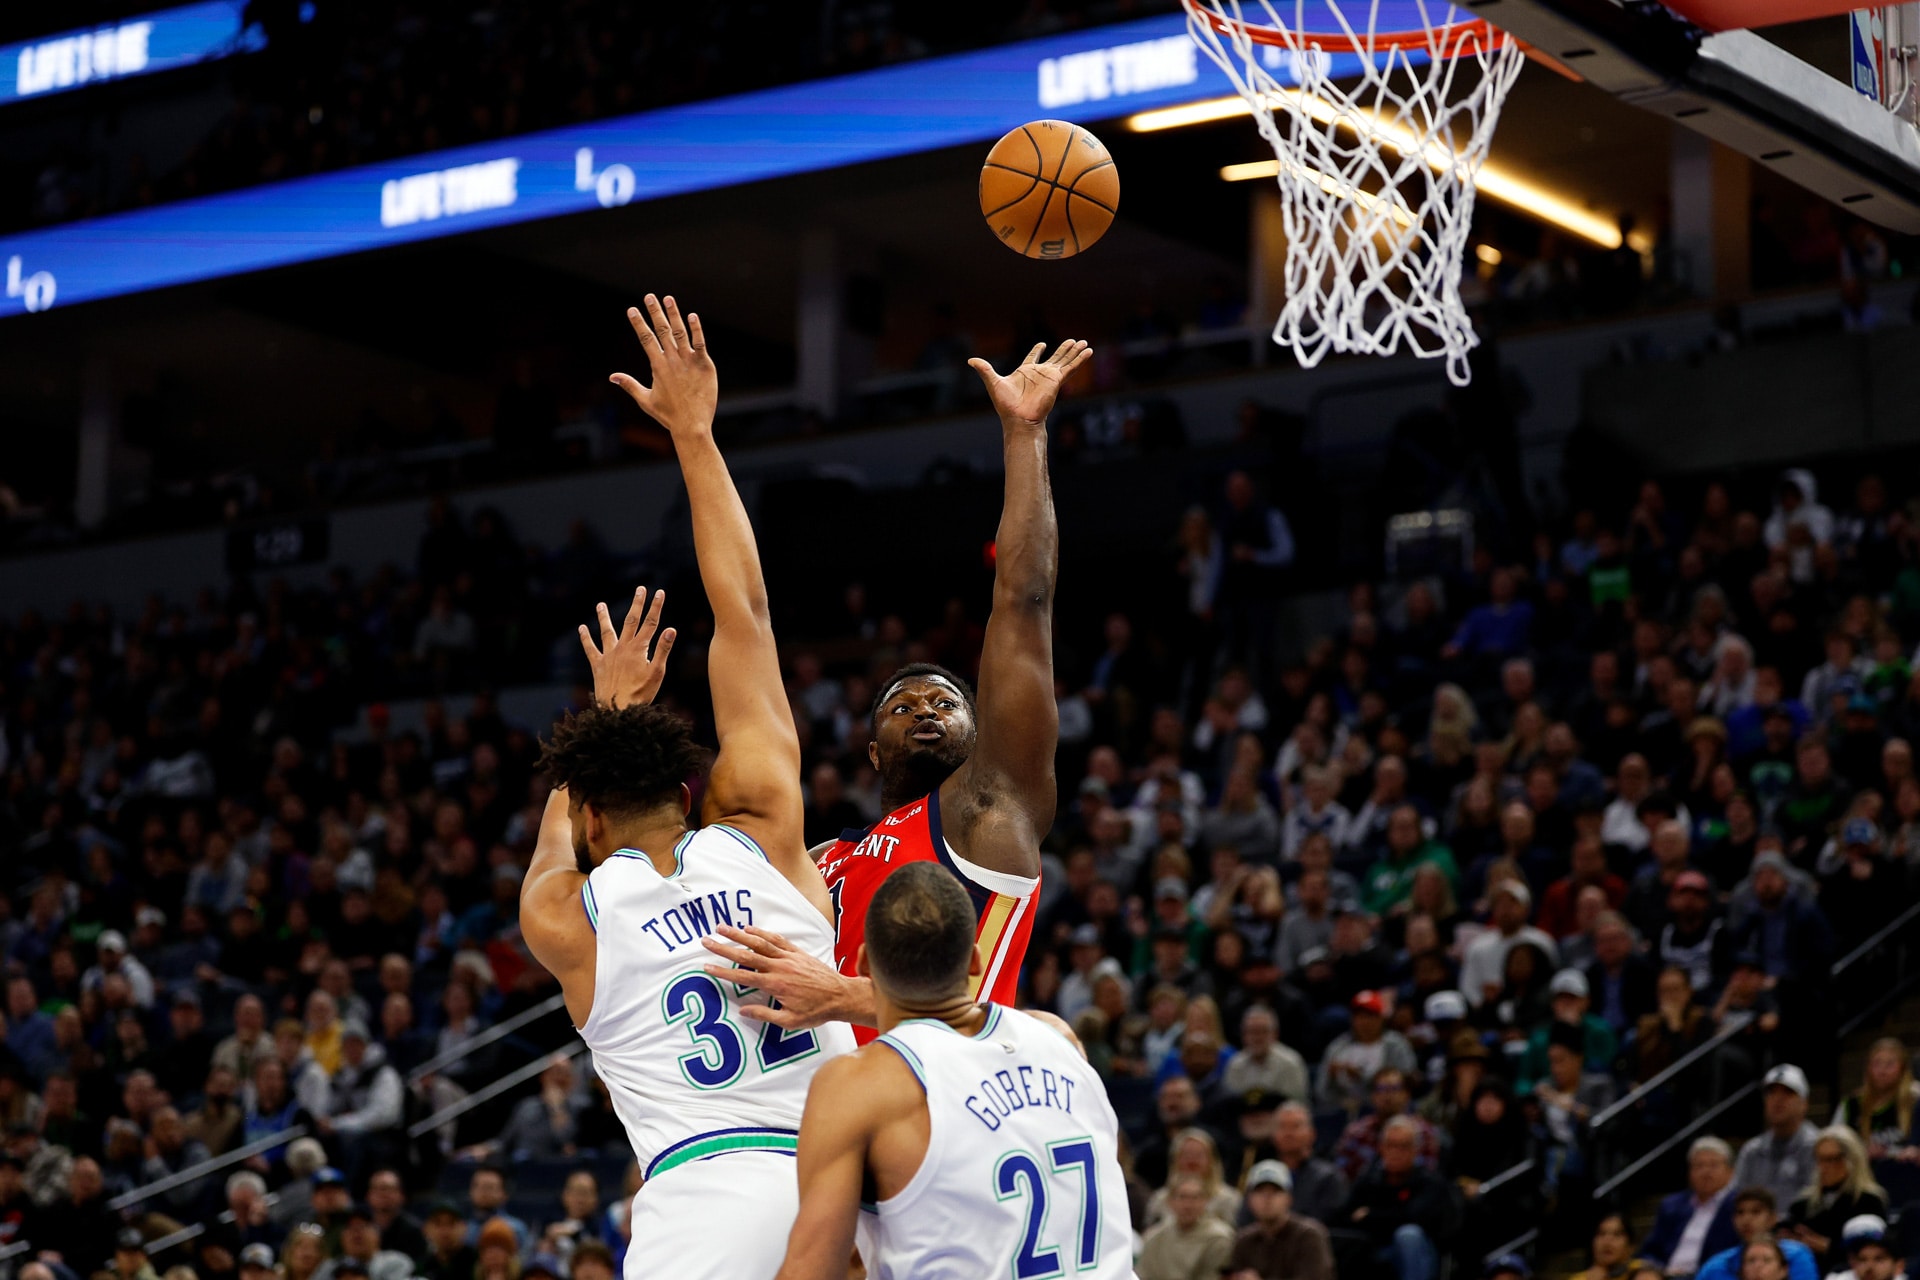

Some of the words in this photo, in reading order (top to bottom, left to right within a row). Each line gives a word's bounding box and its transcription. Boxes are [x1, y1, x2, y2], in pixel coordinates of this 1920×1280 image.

[641, 889, 753, 952] TOWNS
[965, 1065, 1075, 1132] GOBERT
[993, 1135, 1103, 1280] 27
